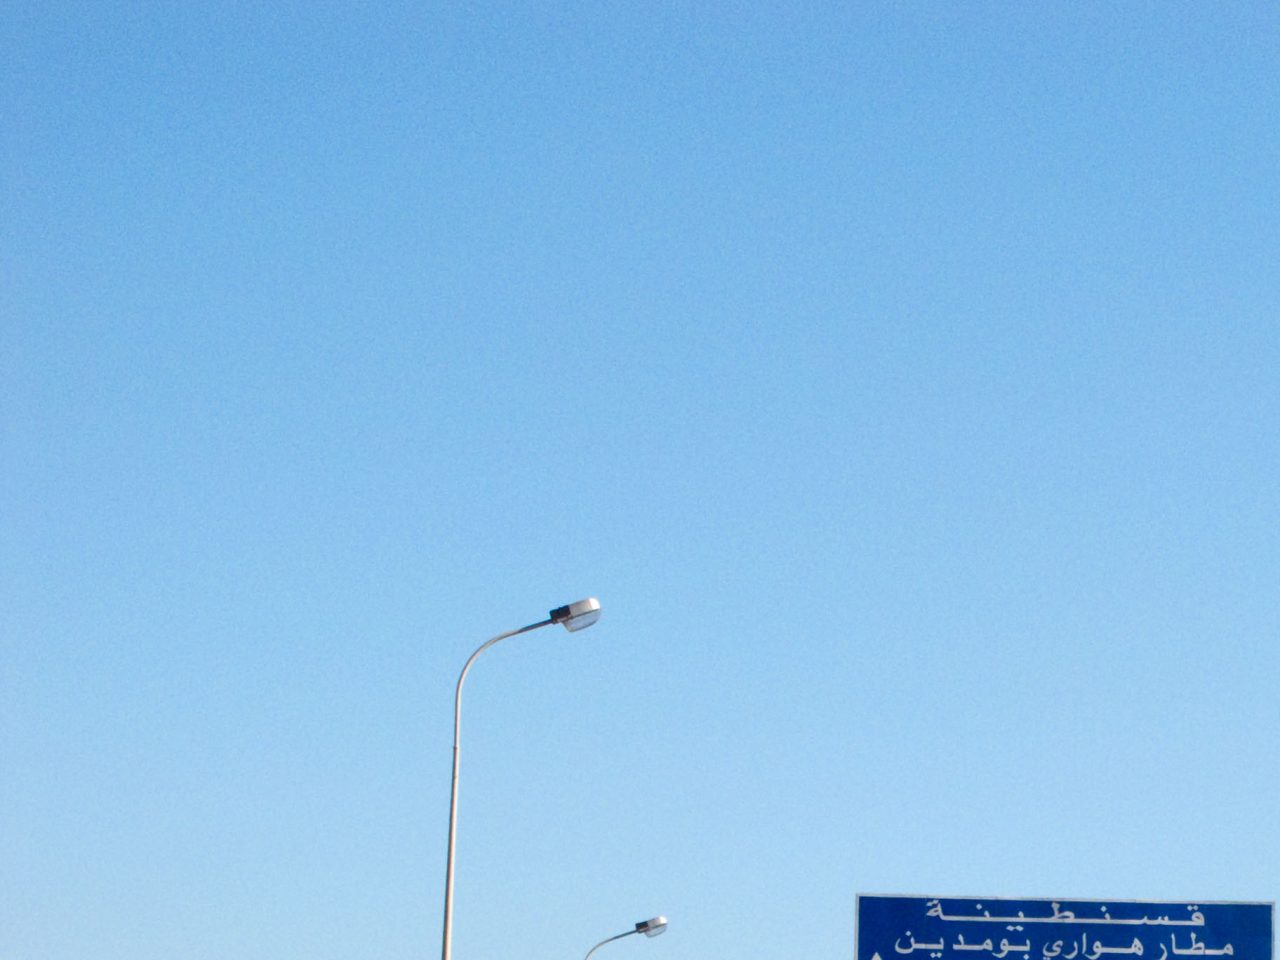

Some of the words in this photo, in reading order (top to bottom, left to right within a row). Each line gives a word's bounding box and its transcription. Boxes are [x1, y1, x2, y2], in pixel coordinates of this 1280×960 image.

[926, 900, 1205, 932] قسنطينة
[895, 930, 1030, 959] بومدين
[1042, 933, 1143, 960] هواري
